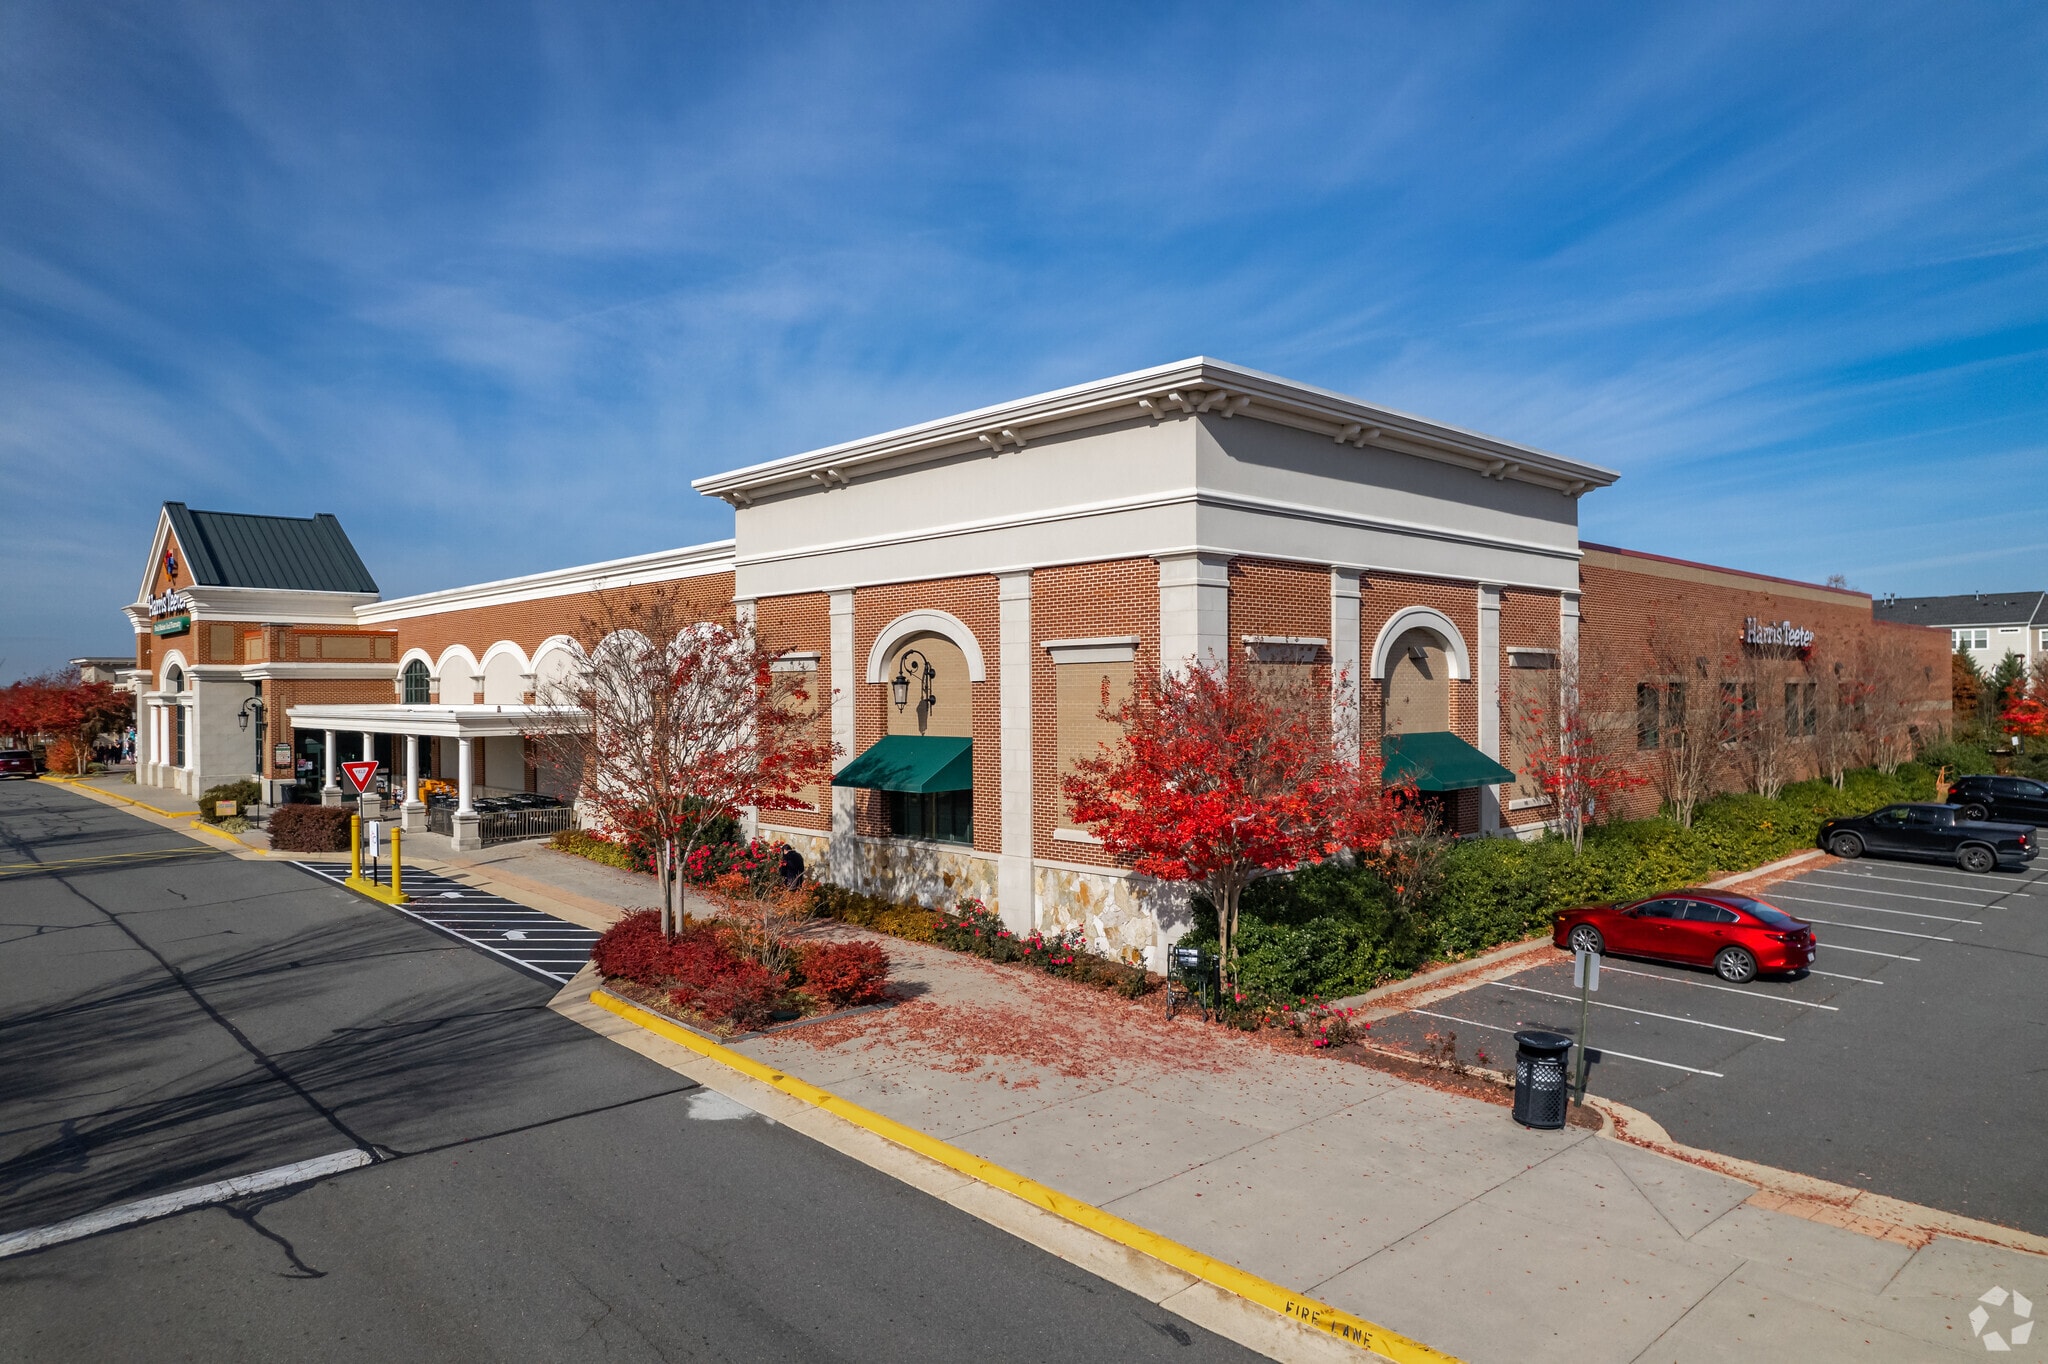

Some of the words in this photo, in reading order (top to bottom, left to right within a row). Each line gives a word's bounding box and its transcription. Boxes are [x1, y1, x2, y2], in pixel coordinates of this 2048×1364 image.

[148, 592, 167, 617] Harris
[1747, 617, 1783, 644] Harris
[1782, 620, 1815, 647] Teeter
[1285, 1301, 1320, 1326] FIRE
[1331, 1320, 1373, 1349] LANE
